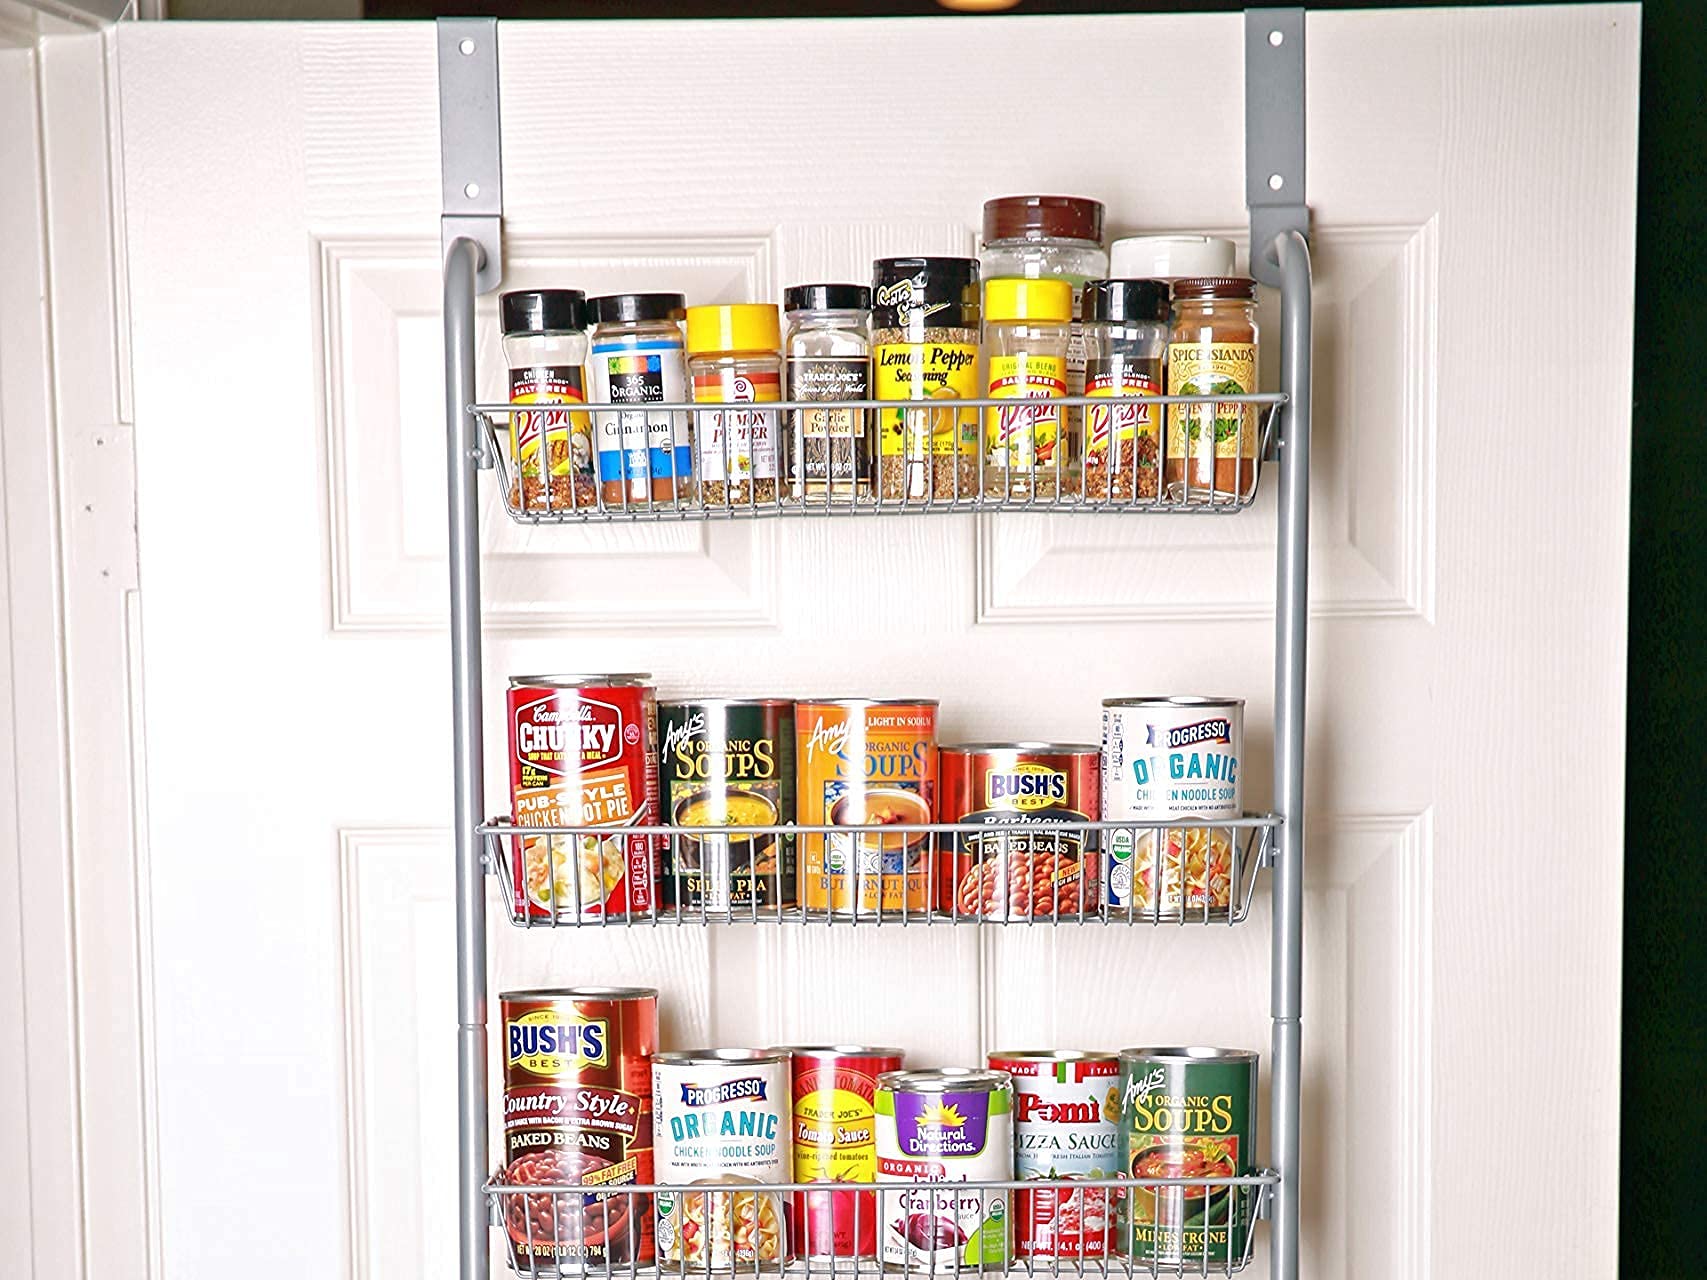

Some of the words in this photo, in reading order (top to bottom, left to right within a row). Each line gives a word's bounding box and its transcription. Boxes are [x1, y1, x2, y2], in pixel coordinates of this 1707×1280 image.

[880, 348, 924, 366] Lemn
[931, 348, 974, 371] Pepper
[1173, 348, 1202, 362] SPICE
[1002, 362, 1032, 371] ORIGAL
[626, 376, 645, 386] 365
[803, 373, 835, 382] TRADER
[836, 373, 859, 382] JOE'S
[895, 368, 948, 386] Seaning
[1095, 379, 1149, 389] SALFREE
[611, 385, 663, 398] ORGANIC
[1217, 402, 1247, 414] PEPPR
[605, 422, 668, 436] Cinnon
[533, 704, 594, 725] Campll's
[868, 717, 895, 727] LIGHT
[897, 717, 906, 726] IN
[520, 722, 616, 753] CHUKY
[661, 712, 706, 764] Amy's
[806, 716, 860, 764] Amy
[1154, 721, 1225, 748] PROGRESSO
[696, 740, 750, 752] ORANIC
[1133, 753, 1239, 785] OGANIC
[991, 774, 1065, 799] BUSH'S
[1136, 789, 1178, 801] CHEN
[1181, 788, 1217, 801] NOODLE
[1218, 787, 1236, 800] SOUP
[517, 783, 626, 813] PUB-SYLE
[1012, 798, 1045, 806] BEST
[607, 797, 630, 817] PIE
[518, 806, 569, 827] CHICKEN
[984, 842, 1027, 854] BAED
[1029, 841, 1069, 854] BEAS
[509, 1024, 603, 1060] BUSH'S
[530, 1059, 574, 1068] BEST
[1011, 1066, 1035, 1075] MADE
[687, 1080, 761, 1106] PROGRESSO
[1122, 1067, 1166, 1115] Amy's
[503, 1091, 568, 1115] Country
[573, 1090, 629, 1117] Style
[1155, 1096, 1209, 1107] ORGANIC
[838, 1109, 860, 1119] JOE'S
[1135, 1095, 1233, 1133] SOUPS
[670, 1110, 779, 1142] ORGANIC
[798, 1122, 835, 1145] Tomato
[837, 1126, 870, 1145] Sauce
[511, 1132, 553, 1150] BAKED
[554, 1132, 610, 1151] BEANS
[917, 1127, 966, 1141] Natural
[1013, 1134, 1061, 1150] IZZA
[1068, 1133, 1116, 1150] SAUCE
[718, 1146, 752, 1157] OODLE
[754, 1143, 776, 1156] SOUP
[909, 1138, 974, 1153] Directions
[617, 1161, 637, 1176] FREE
[883, 1162, 941, 1174] ORGANIC
